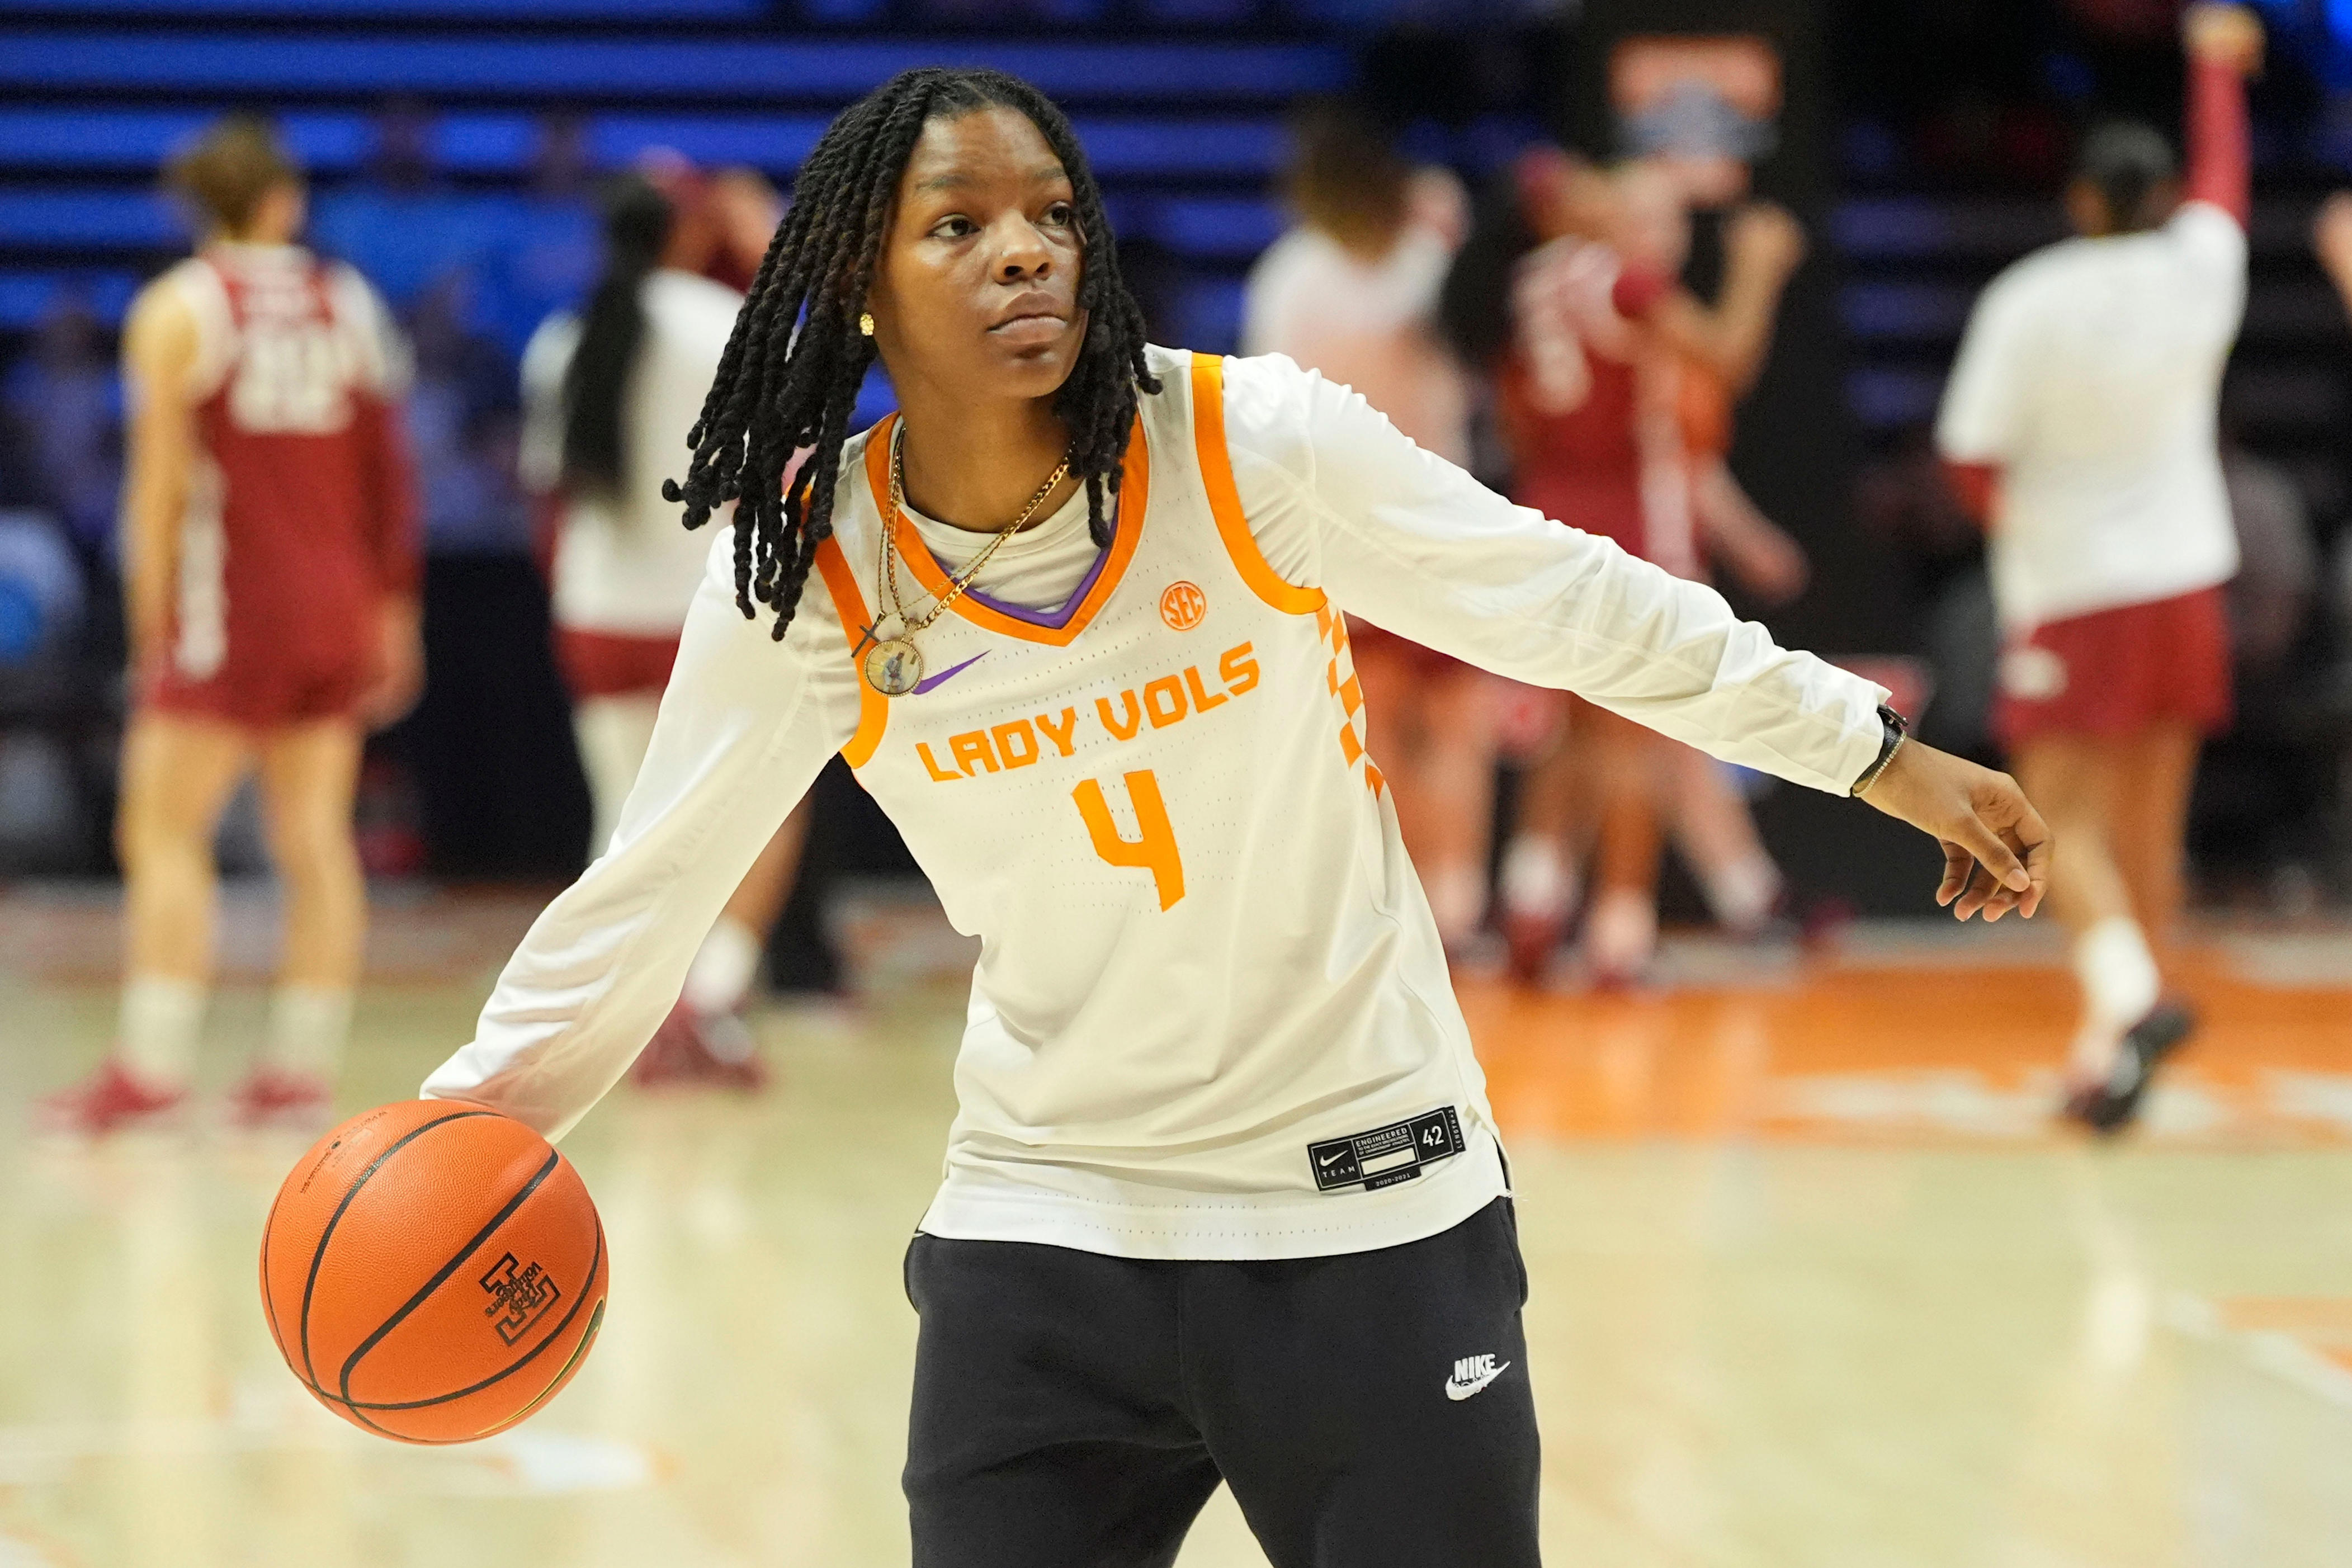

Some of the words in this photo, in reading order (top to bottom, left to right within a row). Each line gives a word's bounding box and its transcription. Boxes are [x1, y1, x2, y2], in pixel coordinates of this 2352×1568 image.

[1164, 585, 1202, 627] SEC
[915, 707, 1076, 782] LADY
[1094, 641, 1260, 740] VOLS
[1070, 769, 1186, 912] 4
[1356, 1127, 1408, 1147] ENGINEERED
[1422, 1126, 1445, 1147] 42
[1451, 1119, 1462, 1149] LENGTH
[1323, 1165, 1356, 1178] TEAM
[1454, 1353, 1496, 1382] NIKE
